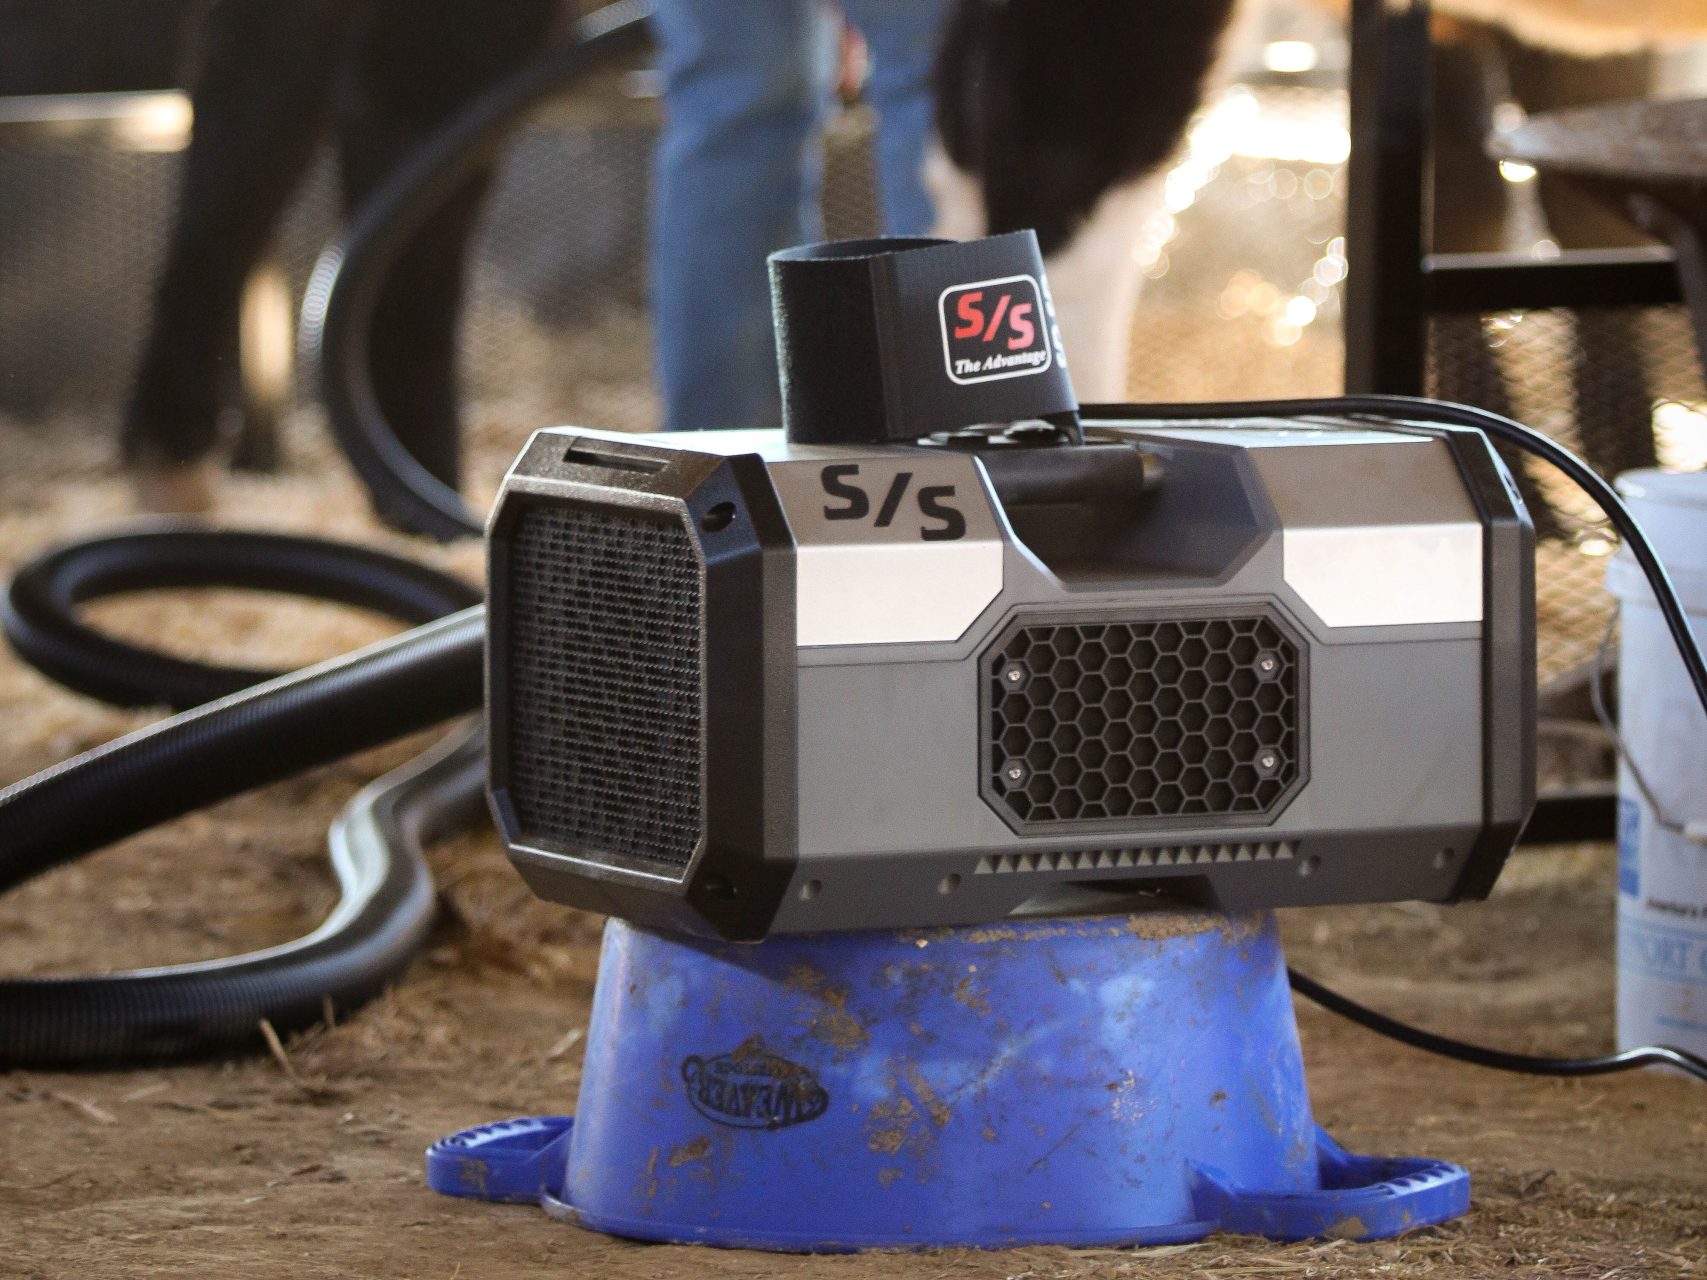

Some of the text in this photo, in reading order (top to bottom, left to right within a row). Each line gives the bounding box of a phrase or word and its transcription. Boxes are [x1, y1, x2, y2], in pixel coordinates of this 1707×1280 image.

[955, 291, 1035, 350] S/S
[954, 348, 1047, 376] The Advantage
[820, 463, 967, 542] S/S
